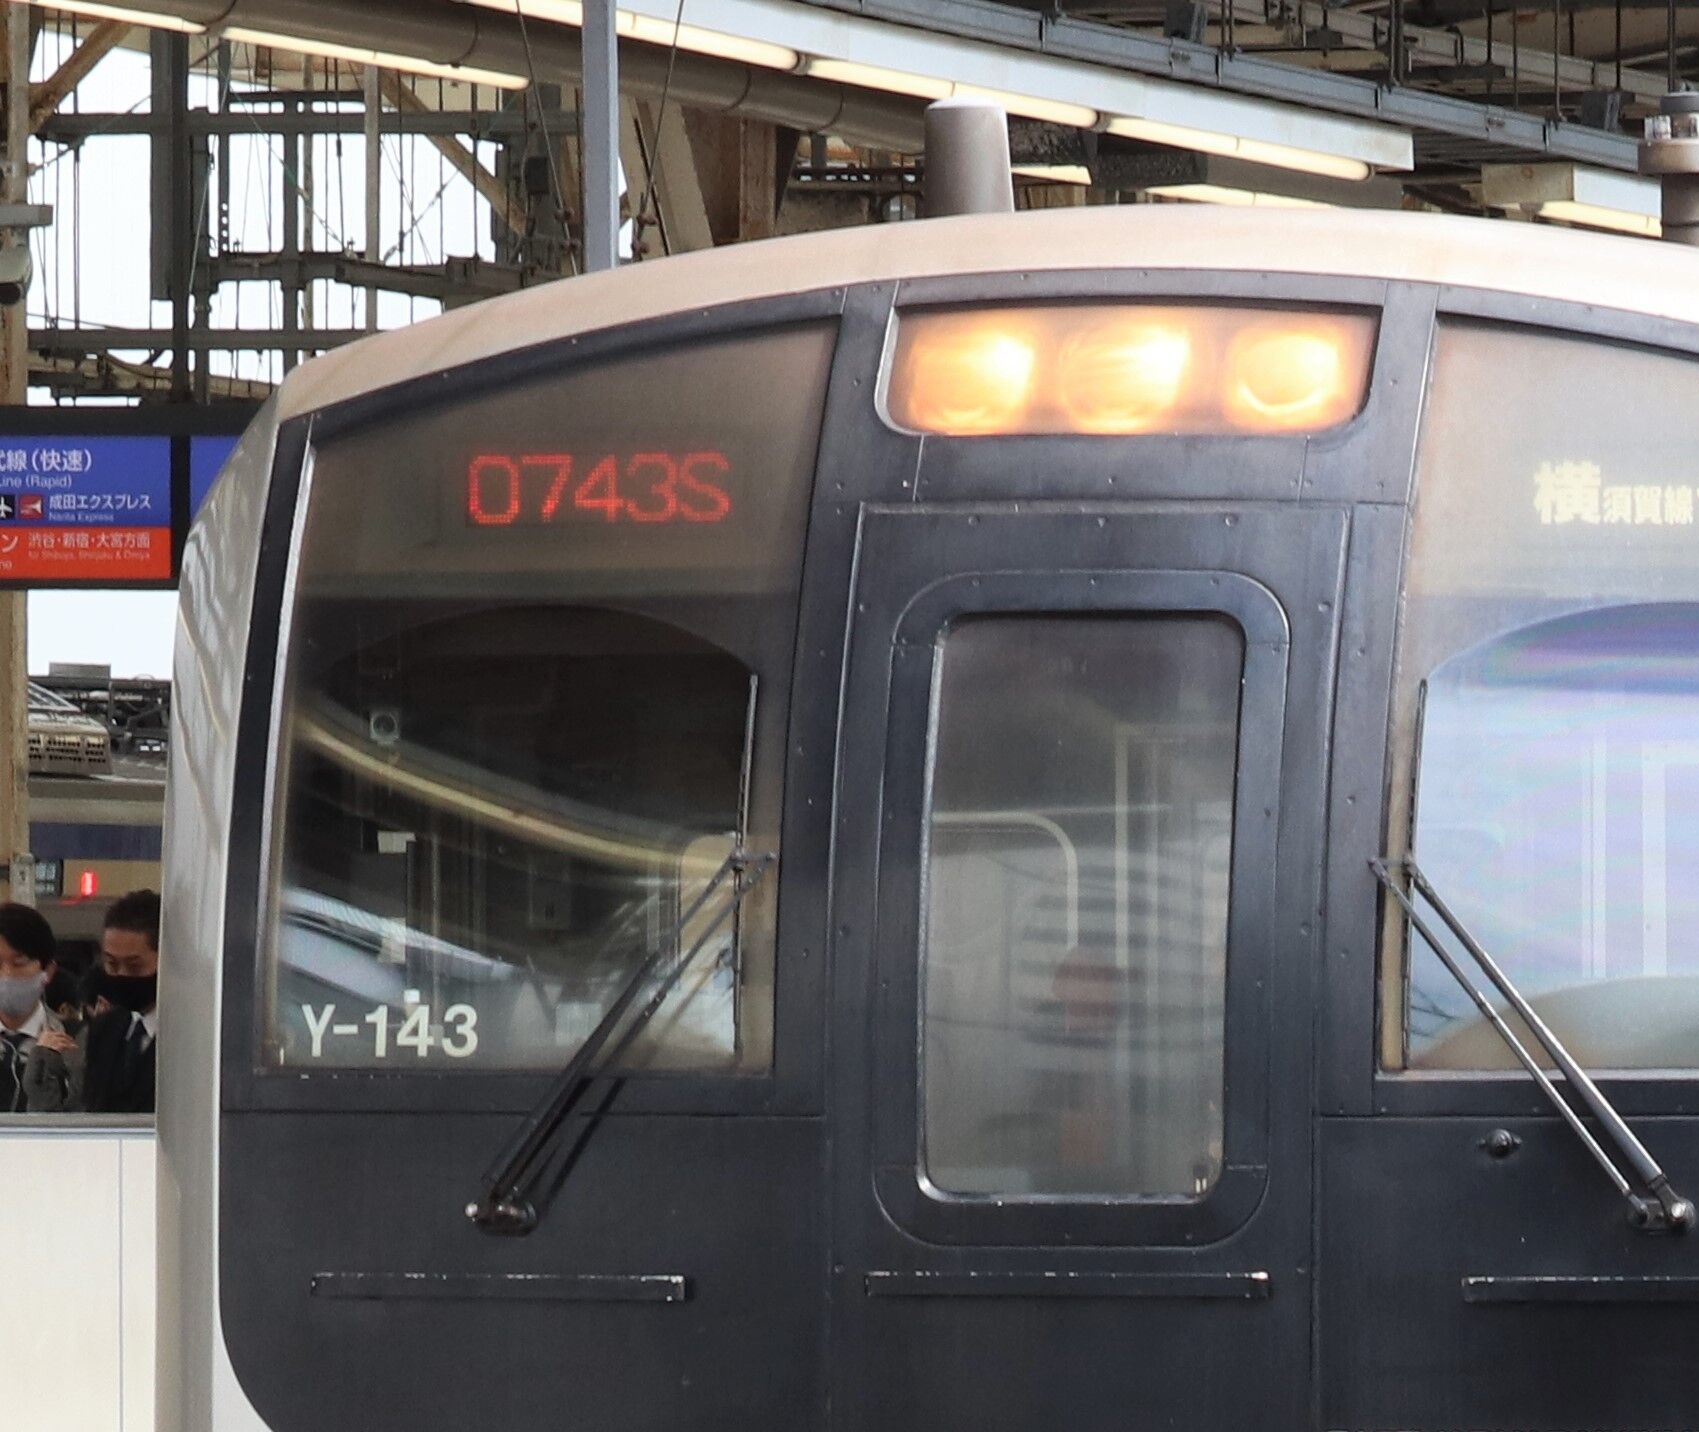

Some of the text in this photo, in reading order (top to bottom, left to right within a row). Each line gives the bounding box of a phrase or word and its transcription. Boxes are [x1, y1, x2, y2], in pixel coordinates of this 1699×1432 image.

[0, 475, 72, 490] ine (Rapid)
[468, 453, 732, 524] 0743S
[49, 494, 151, 510] 成田エクスプレス
[302, 1003, 478, 1058] Y-143
